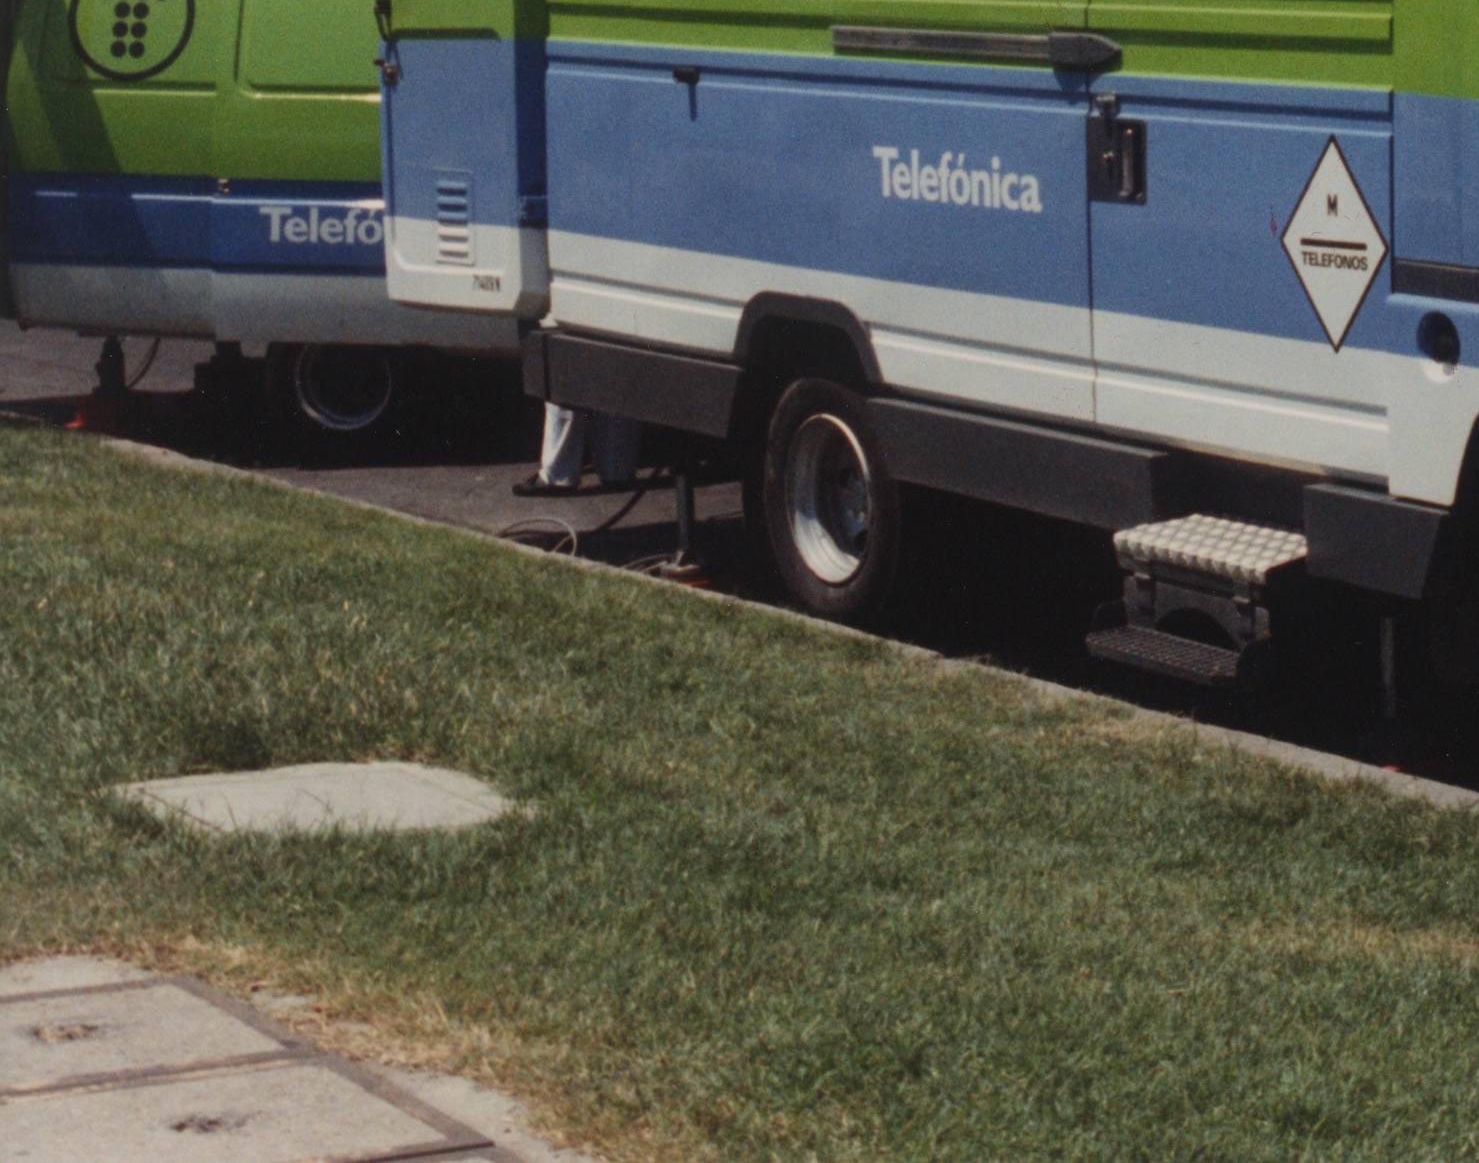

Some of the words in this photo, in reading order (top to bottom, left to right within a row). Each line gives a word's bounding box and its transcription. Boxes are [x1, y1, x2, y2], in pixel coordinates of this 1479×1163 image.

[872, 145, 1043, 213] Telefónica
[1327, 194, 1338, 217] M
[1301, 250, 1368, 271] TELEFONOS
